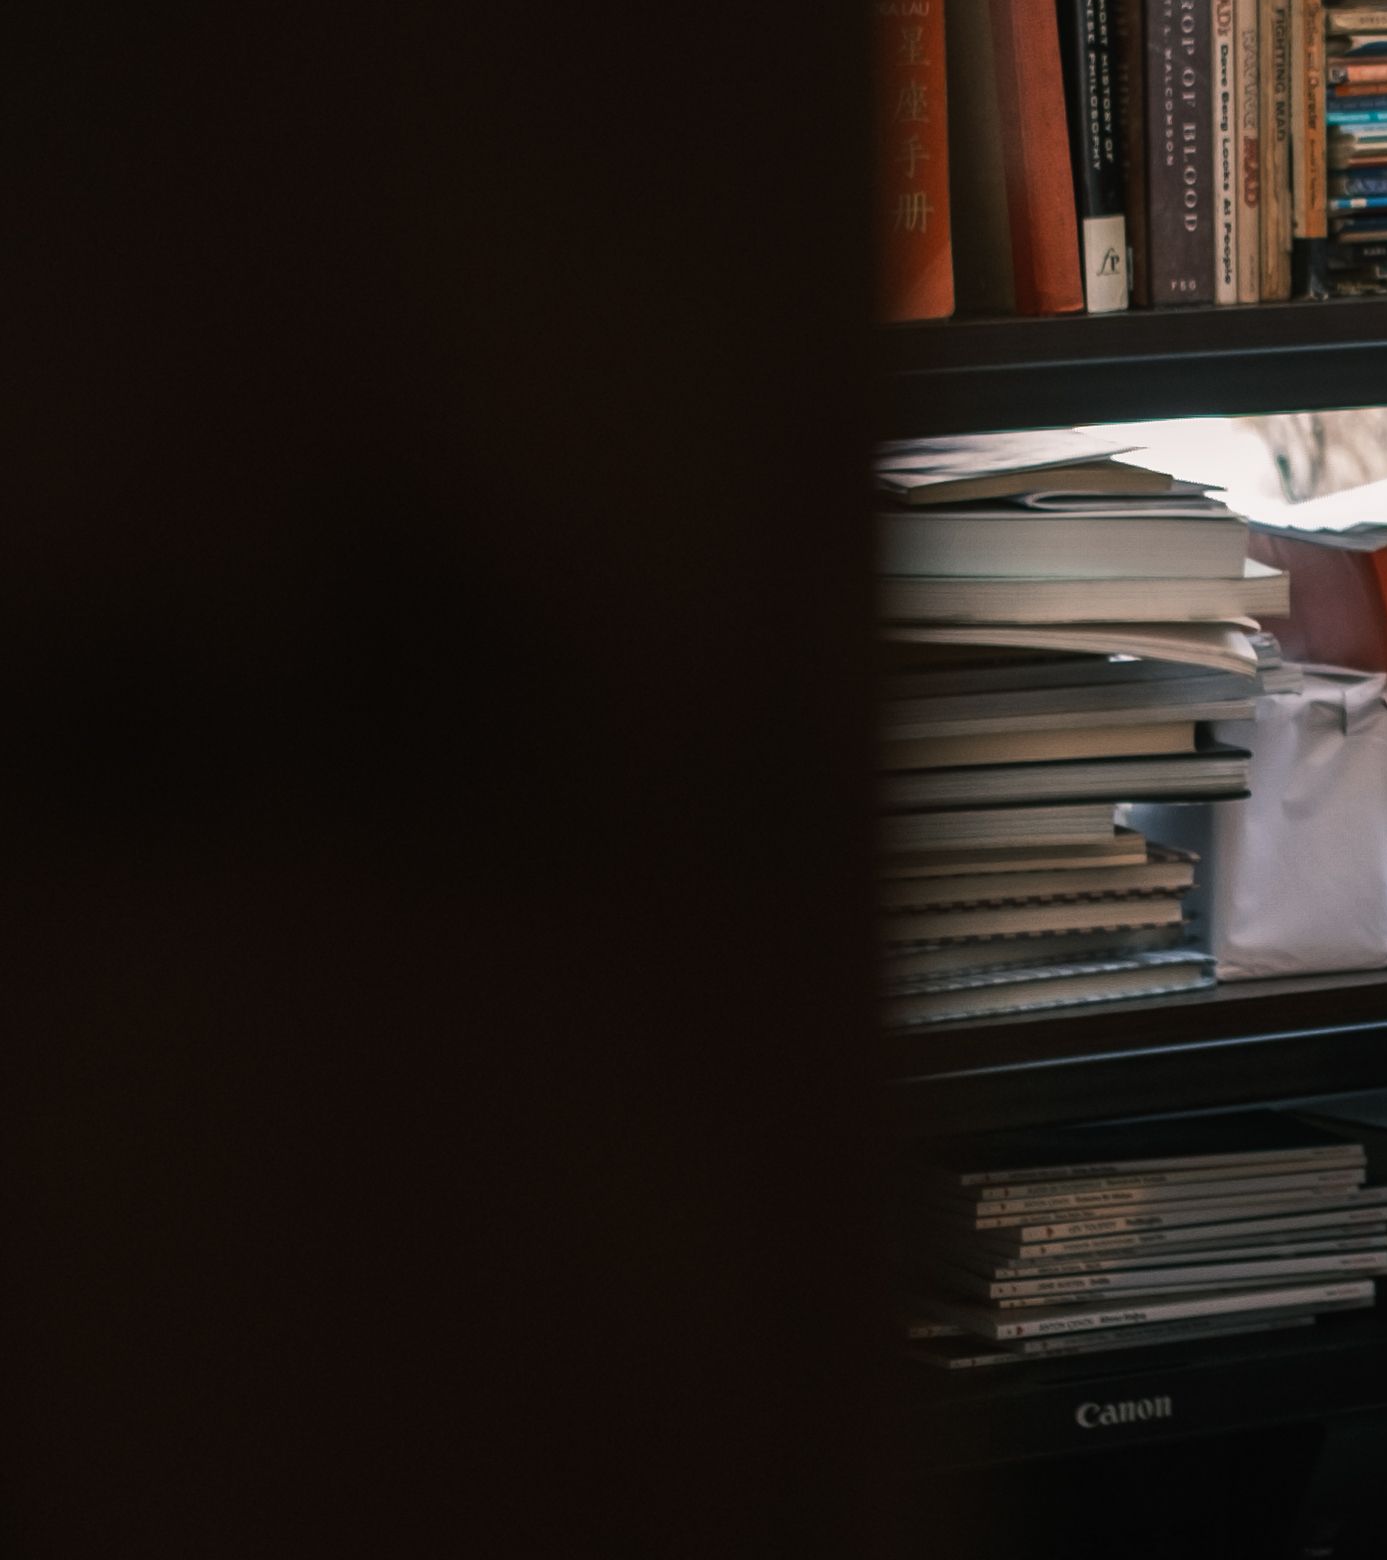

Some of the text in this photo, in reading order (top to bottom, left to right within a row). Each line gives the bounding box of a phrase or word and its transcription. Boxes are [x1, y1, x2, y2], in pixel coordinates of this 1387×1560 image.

[1181, 66, 1198, 108] OF
[1219, 44, 1231, 87] Dave
[1274, 8, 1286, 142] FIGHTING MAD
[1087, 52, 1101, 171] PHILOSOPHY
[1100, 54, 1112, 133] HISTORY
[1218, 92, 1231, 131] Berg
[1103, 138, 1114, 162] OF
[1180, 116, 1201, 234] BLOOD
[1221, 137, 1232, 192] Looks
[1242, 136, 1259, 209] MAD
[1222, 198, 1232, 218] At
[1220, 223, 1233, 286] People
[1075, 1394, 1173, 1429] Canon
